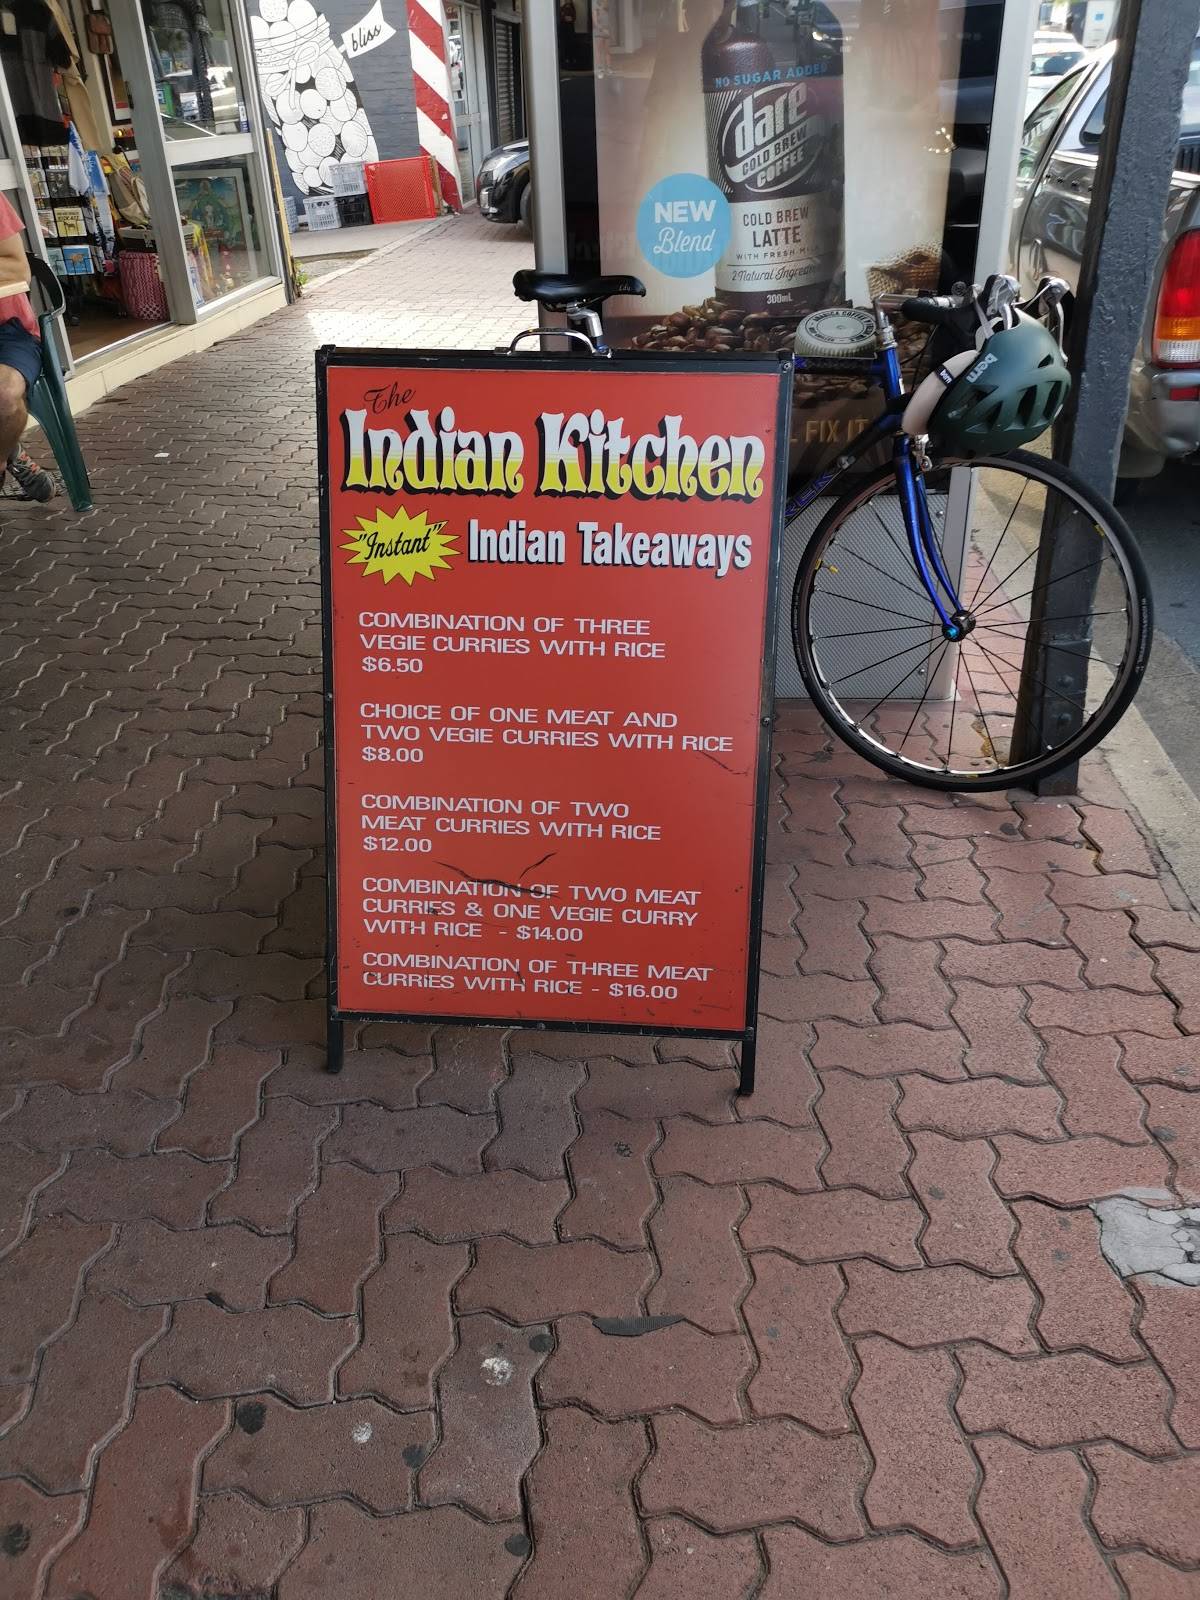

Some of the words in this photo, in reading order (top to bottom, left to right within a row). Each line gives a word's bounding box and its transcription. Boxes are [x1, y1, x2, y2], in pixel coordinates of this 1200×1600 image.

[351, 25, 382, 52] bliss
[714, 76, 730, 88] NO
[733, 69, 781, 86] SUGAR
[786, 63, 828, 79] ADDED
[735, 82, 807, 159] dare
[742, 149, 771, 176] COLD
[774, 123, 808, 157] BREW
[756, 145, 805, 188] COFFEE
[654, 200, 717, 224] NEW
[743, 212, 773, 227] COLD
[776, 206, 809, 223] BREW
[653, 226, 716, 254] Blend
[752, 225, 802, 248] LATTE
[736, 253, 760, 261] WITH
[763, 249, 795, 259] FRESH
[732, 270, 738, 281] 2
[738, 269, 774, 282] Natural
[766, 294, 793, 304] 300mL
[363, 382, 416, 416] The
[805, 420, 841, 443] FIX
[340, 406, 524, 497] Indian
[535, 408, 766, 500] Kitchen
[468, 518, 566, 564] Indian
[577, 521, 753, 578] Takeaways
[359, 612, 524, 631] COMBINATION
[534, 617, 564, 632] OF
[574, 618, 650, 635] THREE
[360, 634, 426, 650] VEGIE
[433, 636, 530, 654] CURRIES
[540, 640, 605, 656] WITH
[615, 642, 665, 658] RICE
[362, 656, 423, 672] $6.50
[360, 703, 441, 719] CHOICE
[451, 706, 480, 721] OF
[490, 707, 538, 723] ONE
[548, 709, 614, 725] MEAT
[623, 712, 677, 727] AND
[361, 725, 420, 740] TWO
[429, 727, 493, 743] VEGIE
[503, 729, 598, 746] CURRIES
[608, 733, 673, 749] WITH
[682, 736, 733, 751] RICE
[362, 746, 423, 762] $8.00
[362, 794, 522, 814] COMBINATION
[531, 801, 560, 815] OF
[570, 802, 628, 818] TWO
[362, 815, 426, 831] MEAT
[436, 818, 530, 835] CURRIES
[539, 822, 602, 837] WITH
[612, 825, 661, 840] RICE
[363, 836, 432, 852] $12.00
[363, 878, 521, 897] COMBINATION
[530, 884, 559, 898] OF
[569, 886, 626, 902] TWO
[636, 889, 701, 905] MEAT
[363, 898, 455, 915] CURRIES
[465, 903, 483, 916] &
[494, 904, 540, 919] ONE
[550, 906, 612, 922] VEGIE
[622, 909, 698, 926] CURRY
[364, 919, 425, 934] WITH
[434, 922, 482, 937] RICE
[516, 925, 582, 941] $14.00
[363, 953, 519, 972] COMBINATION
[529, 960, 557, 973] OF
[567, 961, 638, 977] THREE
[648, 965, 713, 981] MEAT
[363, 972, 454, 988] CURRIES
[464, 976, 525, 991] WITH
[535, 980, 582, 994] RICE
[609, 983, 677, 999] $16.00
